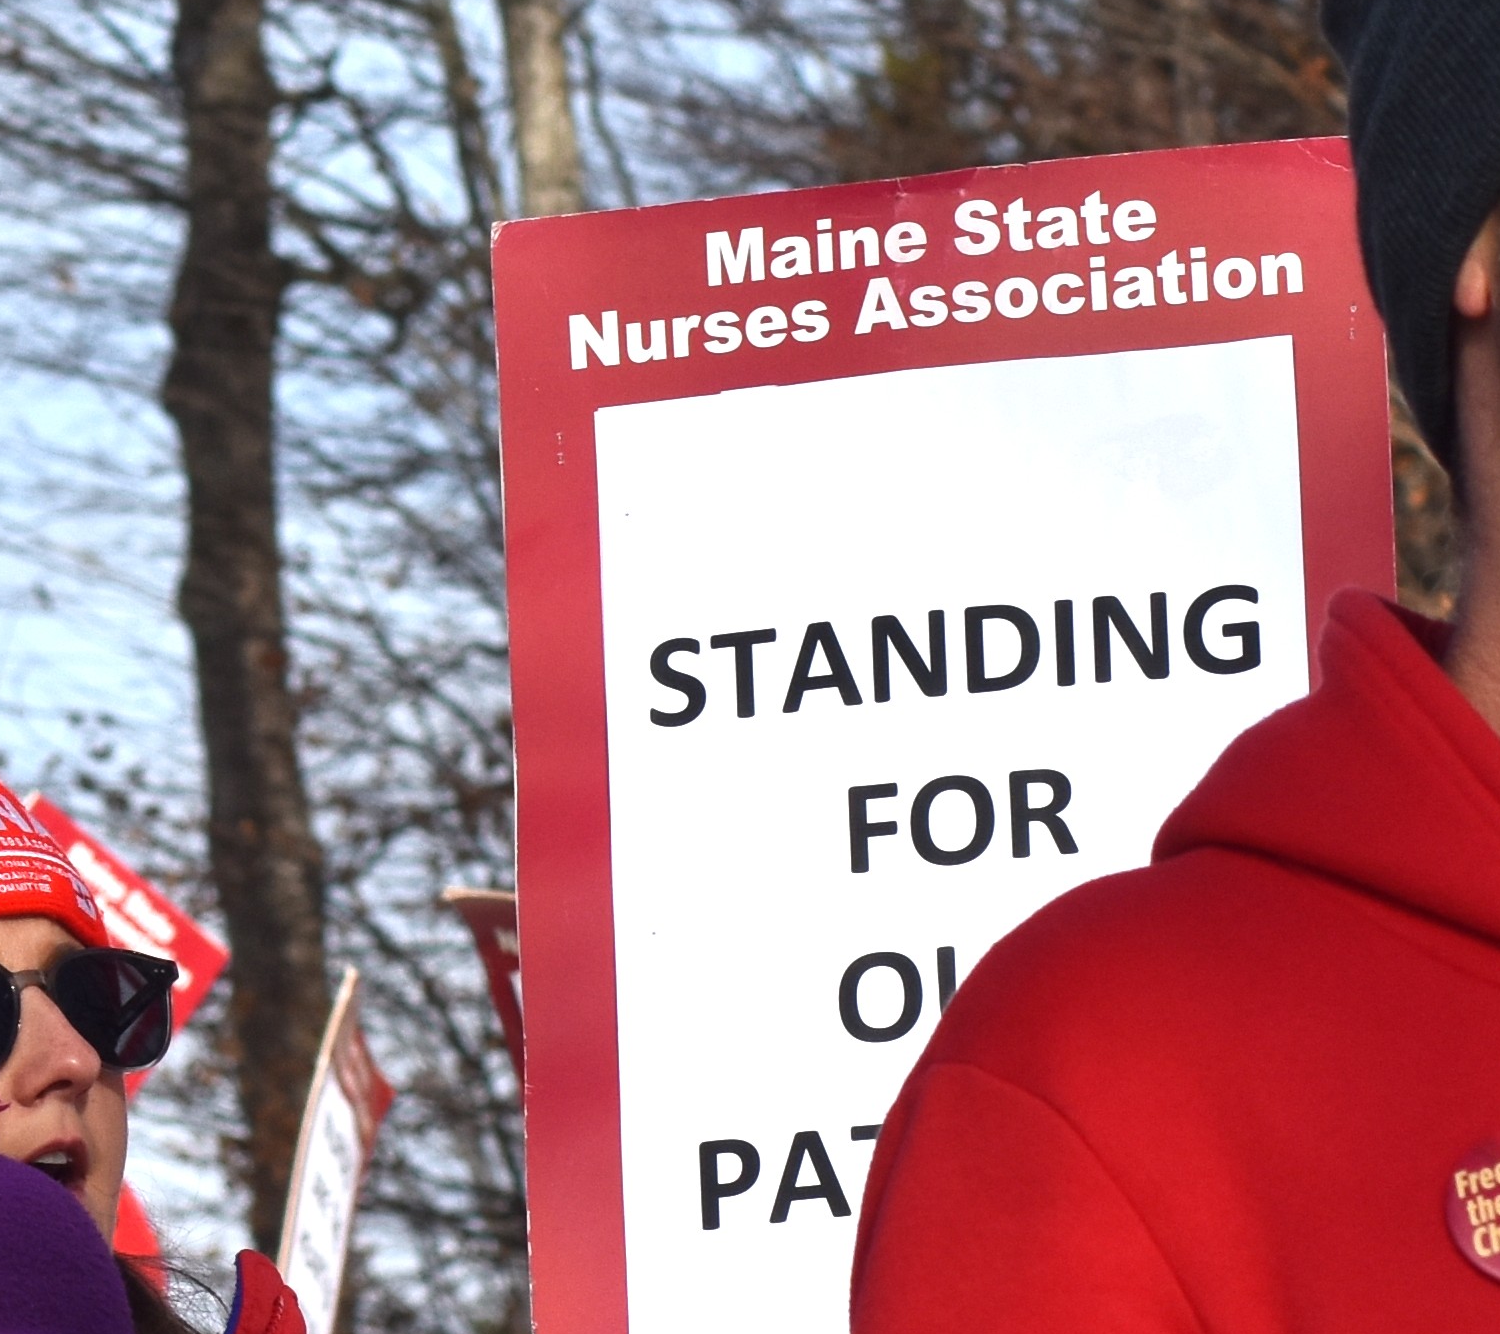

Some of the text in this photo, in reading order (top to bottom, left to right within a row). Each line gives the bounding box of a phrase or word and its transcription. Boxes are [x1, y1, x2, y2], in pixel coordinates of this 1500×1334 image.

[705, 190, 1157, 289] Maine State
[567, 248, 1304, 371] Nurses Association
[648, 584, 1263, 728] STANDING
[847, 768, 1080, 874] FOR
